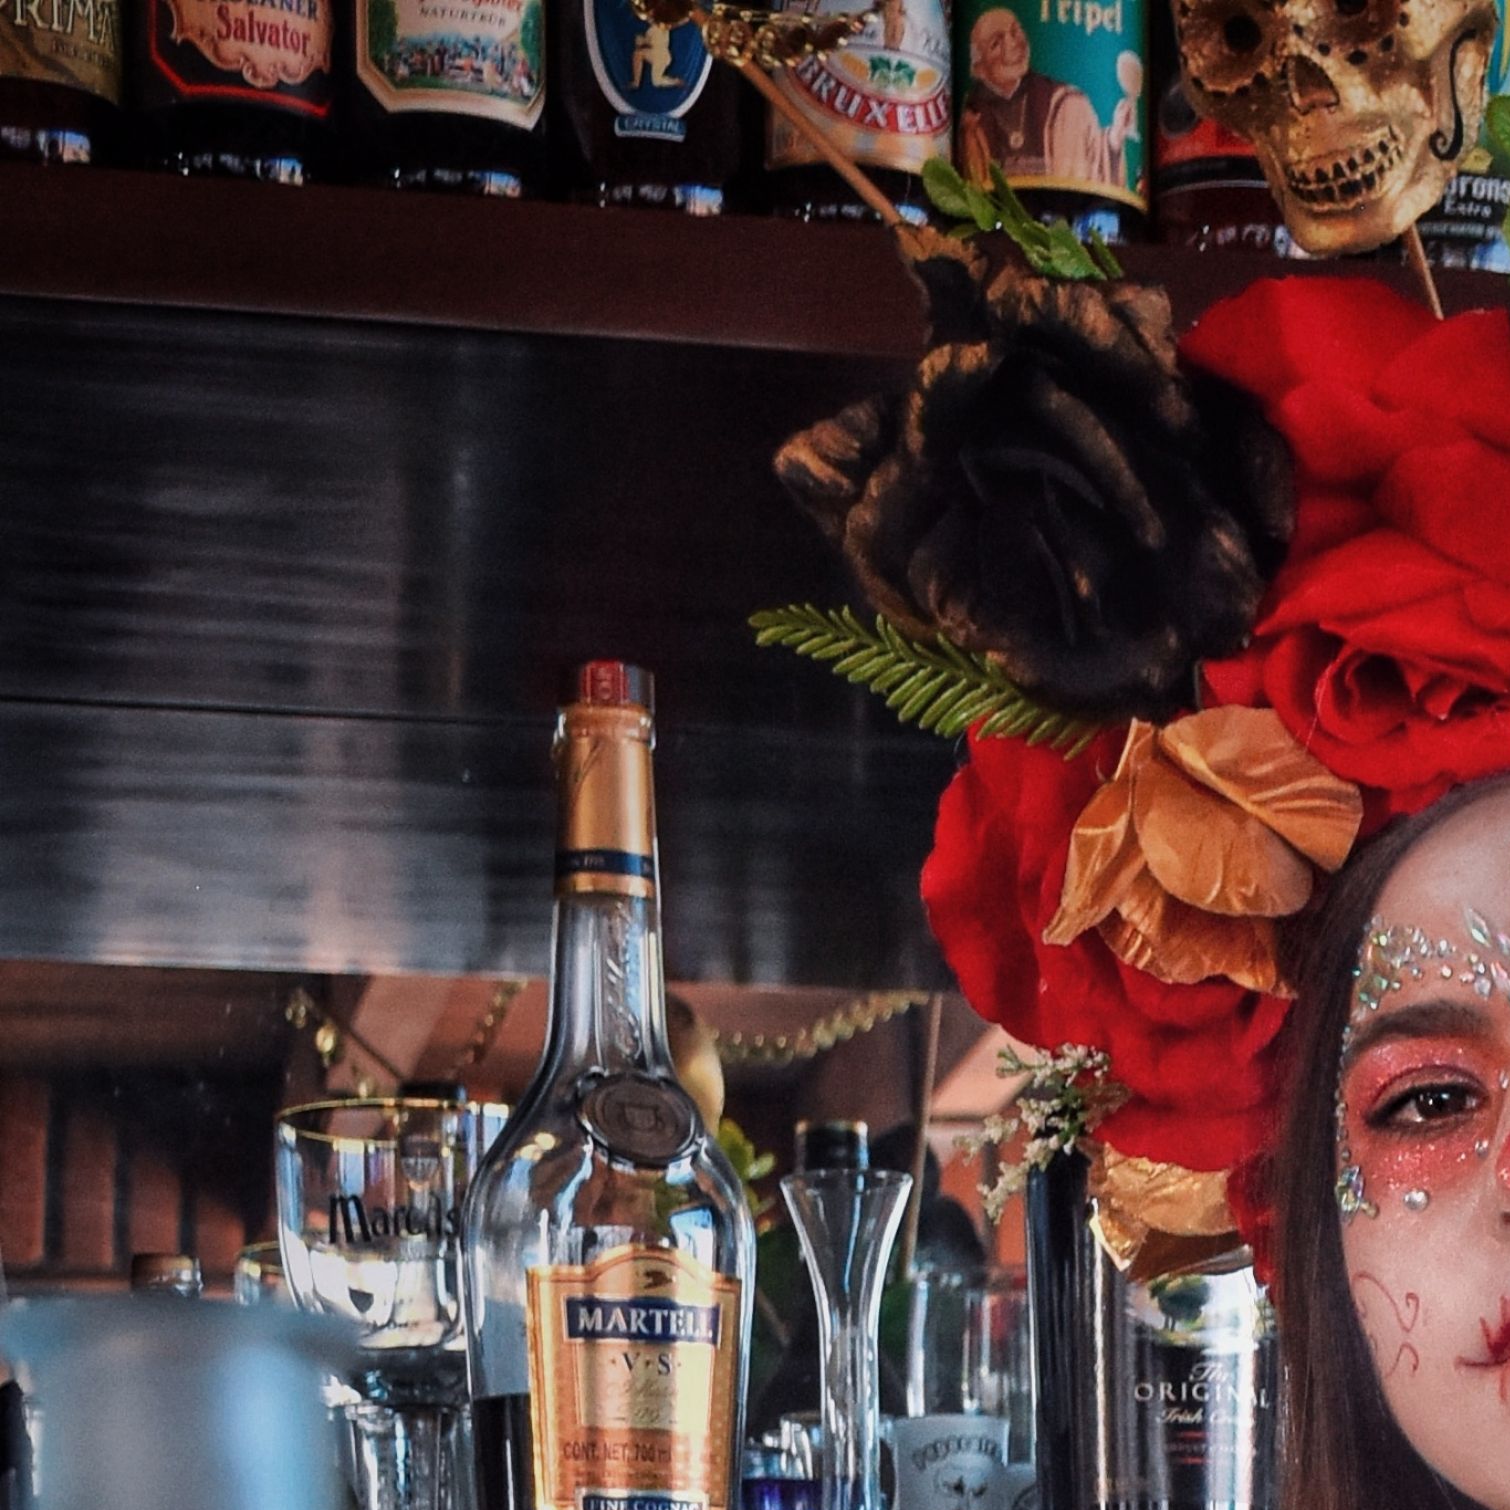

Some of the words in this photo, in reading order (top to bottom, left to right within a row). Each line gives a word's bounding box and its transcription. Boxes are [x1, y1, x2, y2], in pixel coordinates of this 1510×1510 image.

[216, 4, 311, 57] Salvator
[1443, 194, 1493, 218] Extra
[577, 1305, 714, 1338] MARTELL
[1155, 1407, 1205, 1424] Irish
